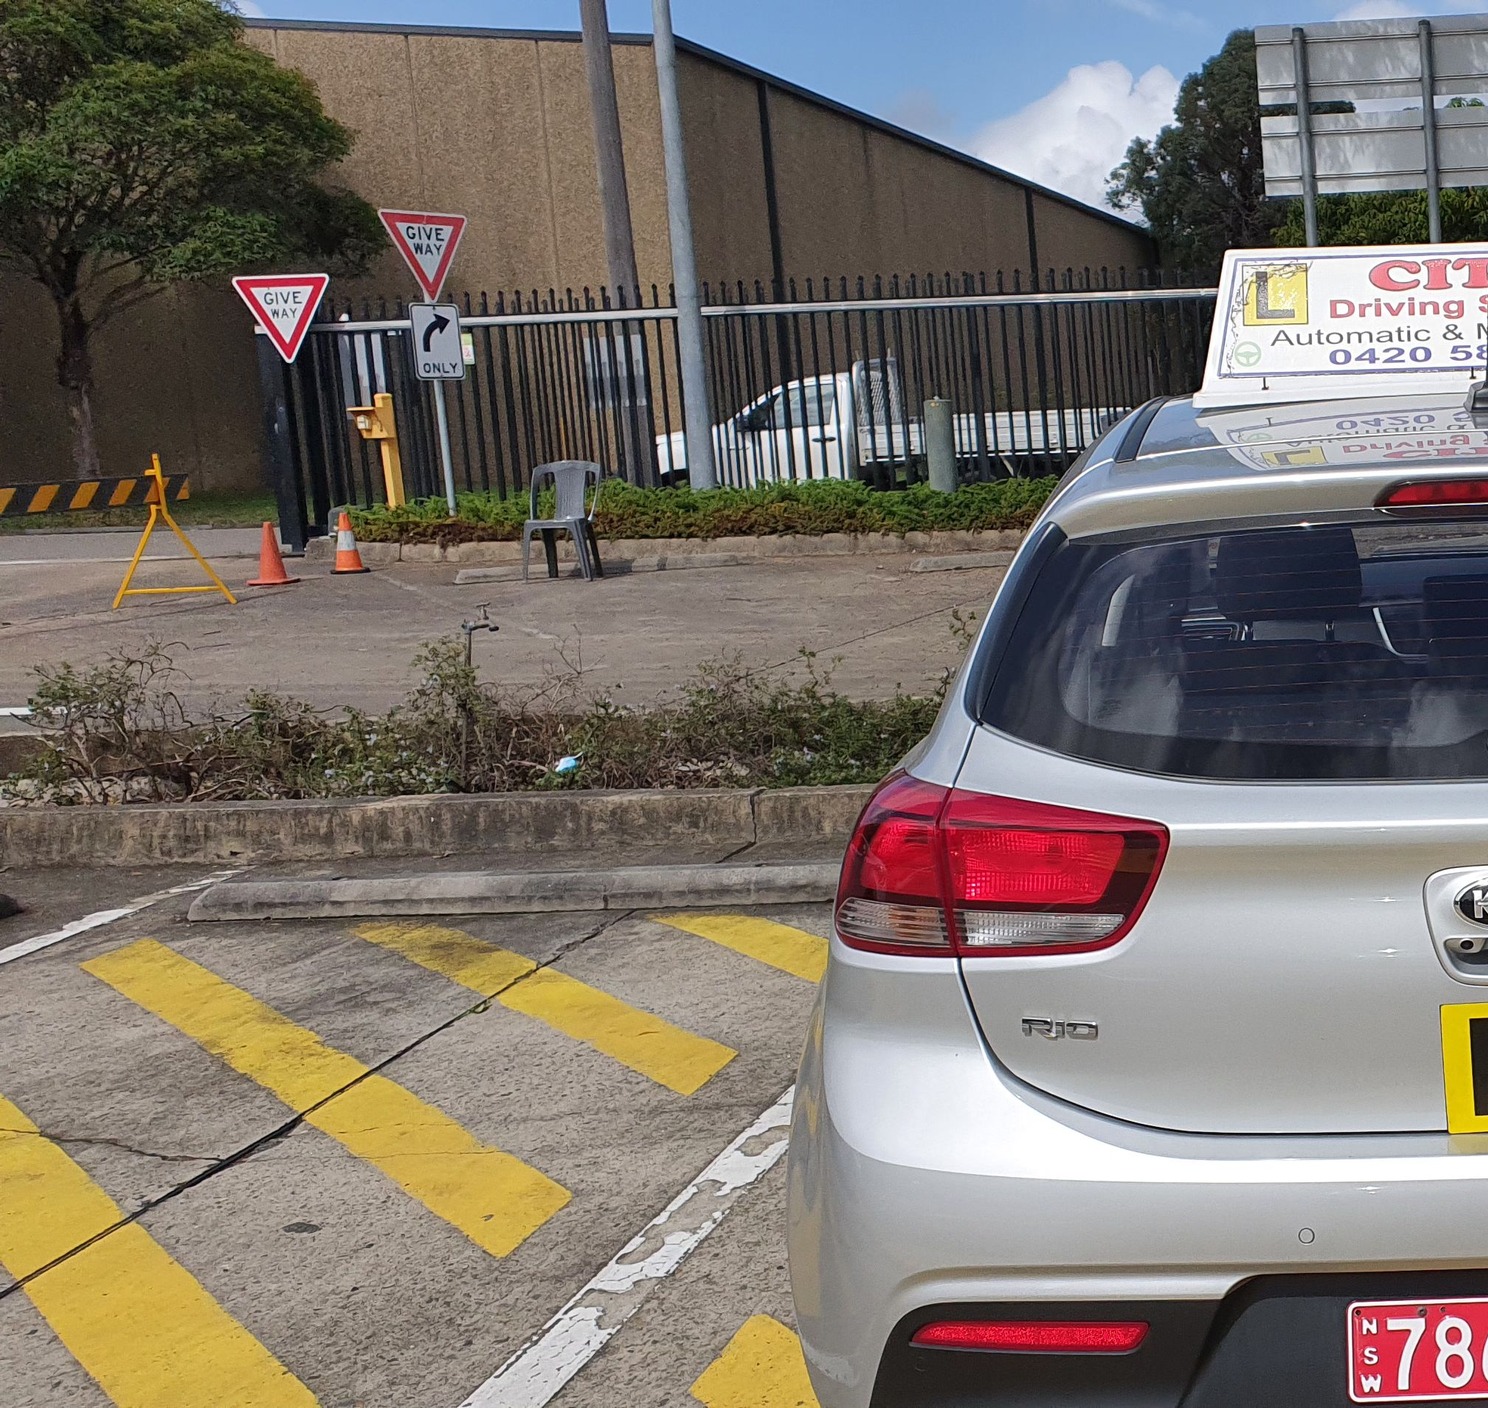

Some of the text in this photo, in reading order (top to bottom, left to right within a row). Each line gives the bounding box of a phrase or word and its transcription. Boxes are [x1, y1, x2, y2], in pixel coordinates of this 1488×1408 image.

[406, 225, 445, 242] GIVE
[413, 242, 443, 256] WAY
[263, 291, 302, 305] GIVE
[1255, 271, 1295, 319] L
[270, 307, 297, 320] WAY
[1329, 297, 1465, 320] Driving
[1270, 325, 1431, 347] Automatic
[1442, 323, 1464, 341] &
[1328, 346, 1433, 366] 0420
[423, 362, 458, 374] ONLY
[1021, 1016, 1099, 1041] RIO
